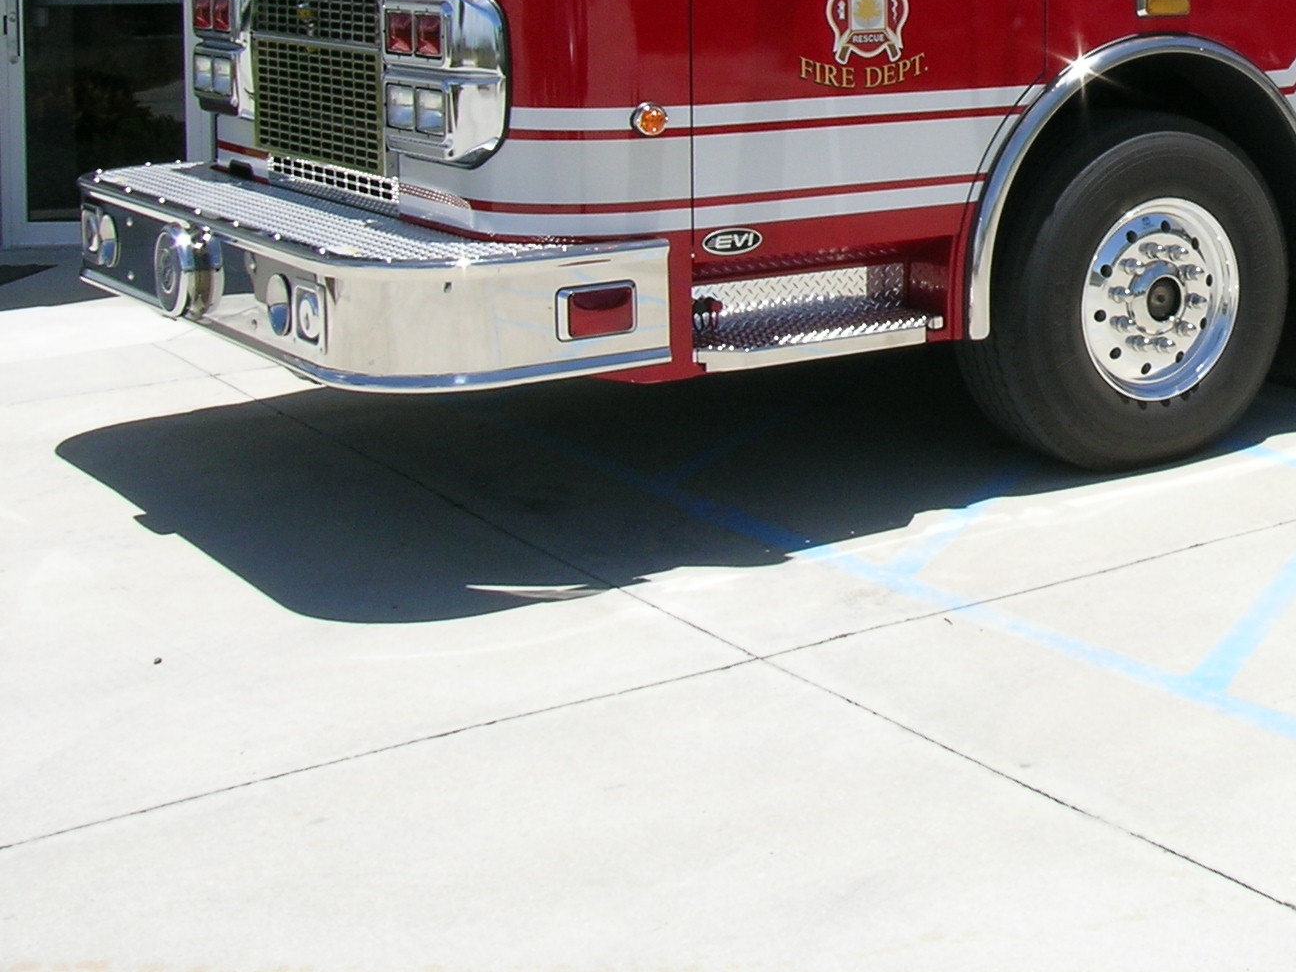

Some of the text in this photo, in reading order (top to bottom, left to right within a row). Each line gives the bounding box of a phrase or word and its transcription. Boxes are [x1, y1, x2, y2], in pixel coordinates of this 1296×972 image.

[852, 33, 886, 44] RESCUE
[800, 53, 929, 89] FIRE DEPT.
[715, 232, 755, 249] EVI
